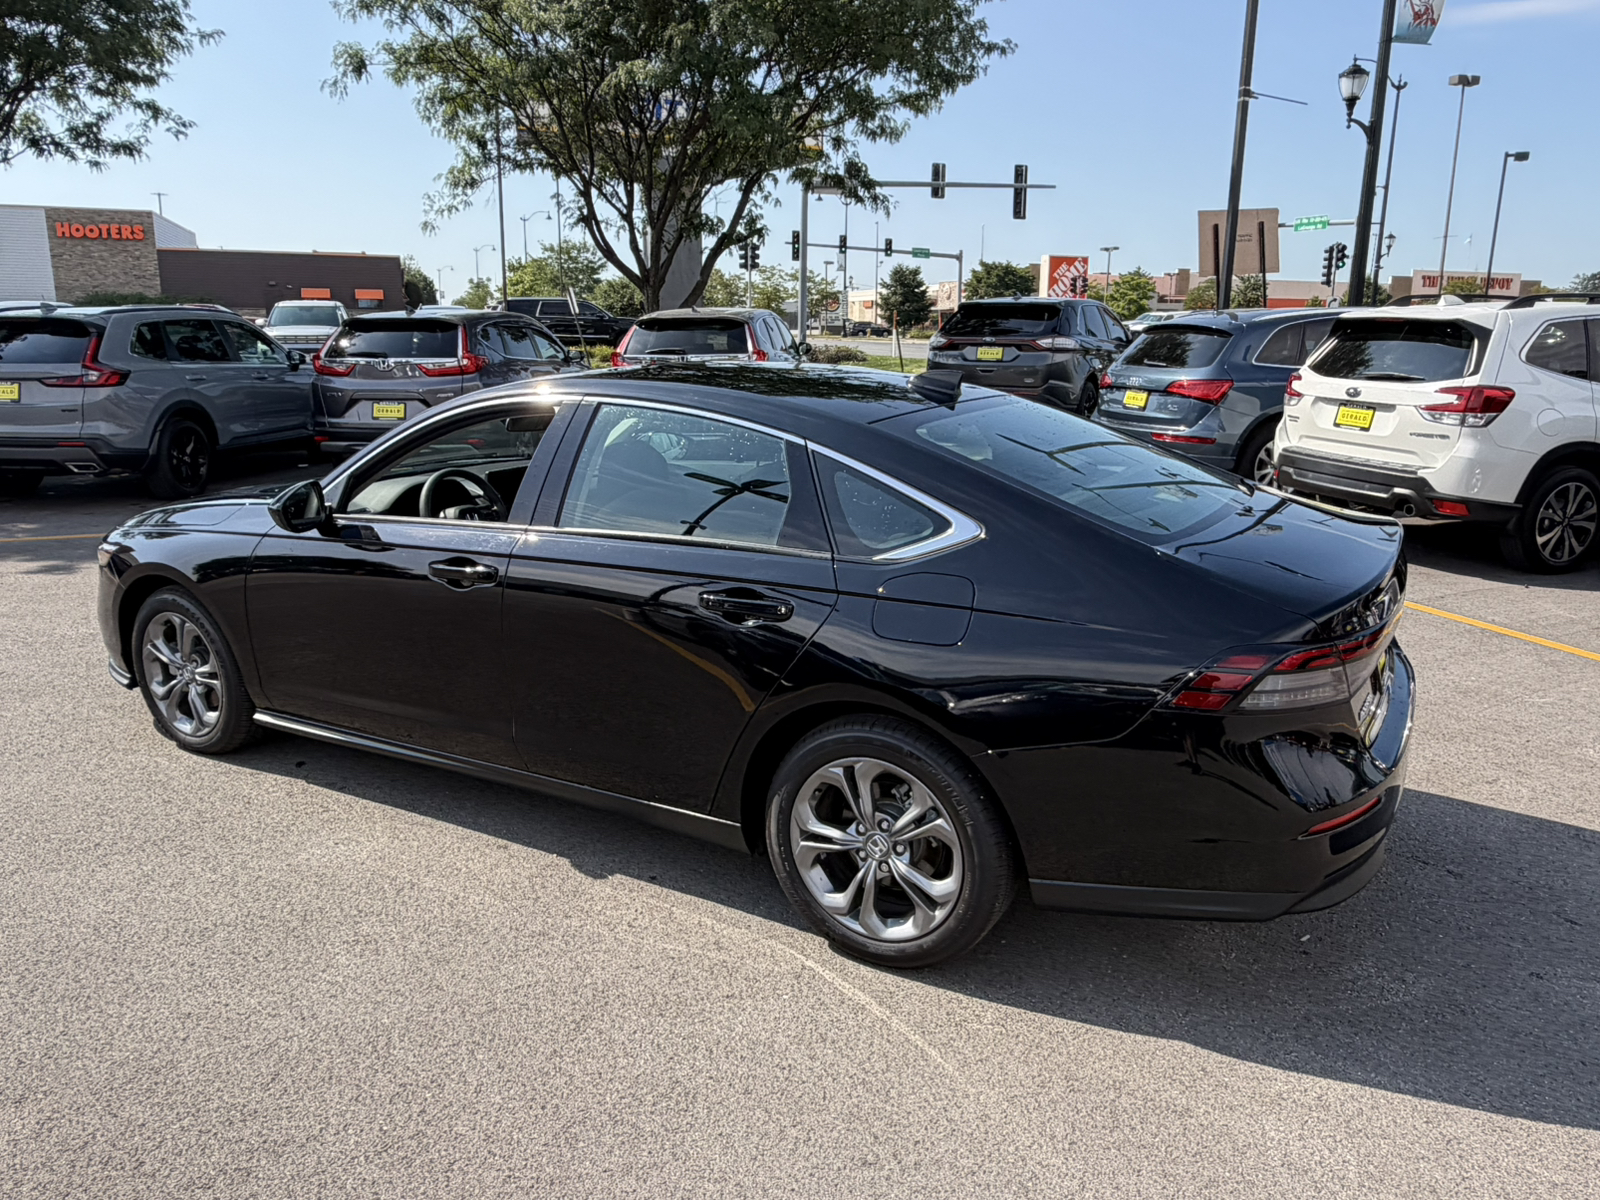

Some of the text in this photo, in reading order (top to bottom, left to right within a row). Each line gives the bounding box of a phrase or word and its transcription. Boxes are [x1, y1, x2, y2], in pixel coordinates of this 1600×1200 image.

[56, 222, 145, 241] HOOTERS
[1048, 257, 1087, 298] HOME
[1052, 261, 1070, 280] THE
[1341, 412, 1367, 422] GERALD
